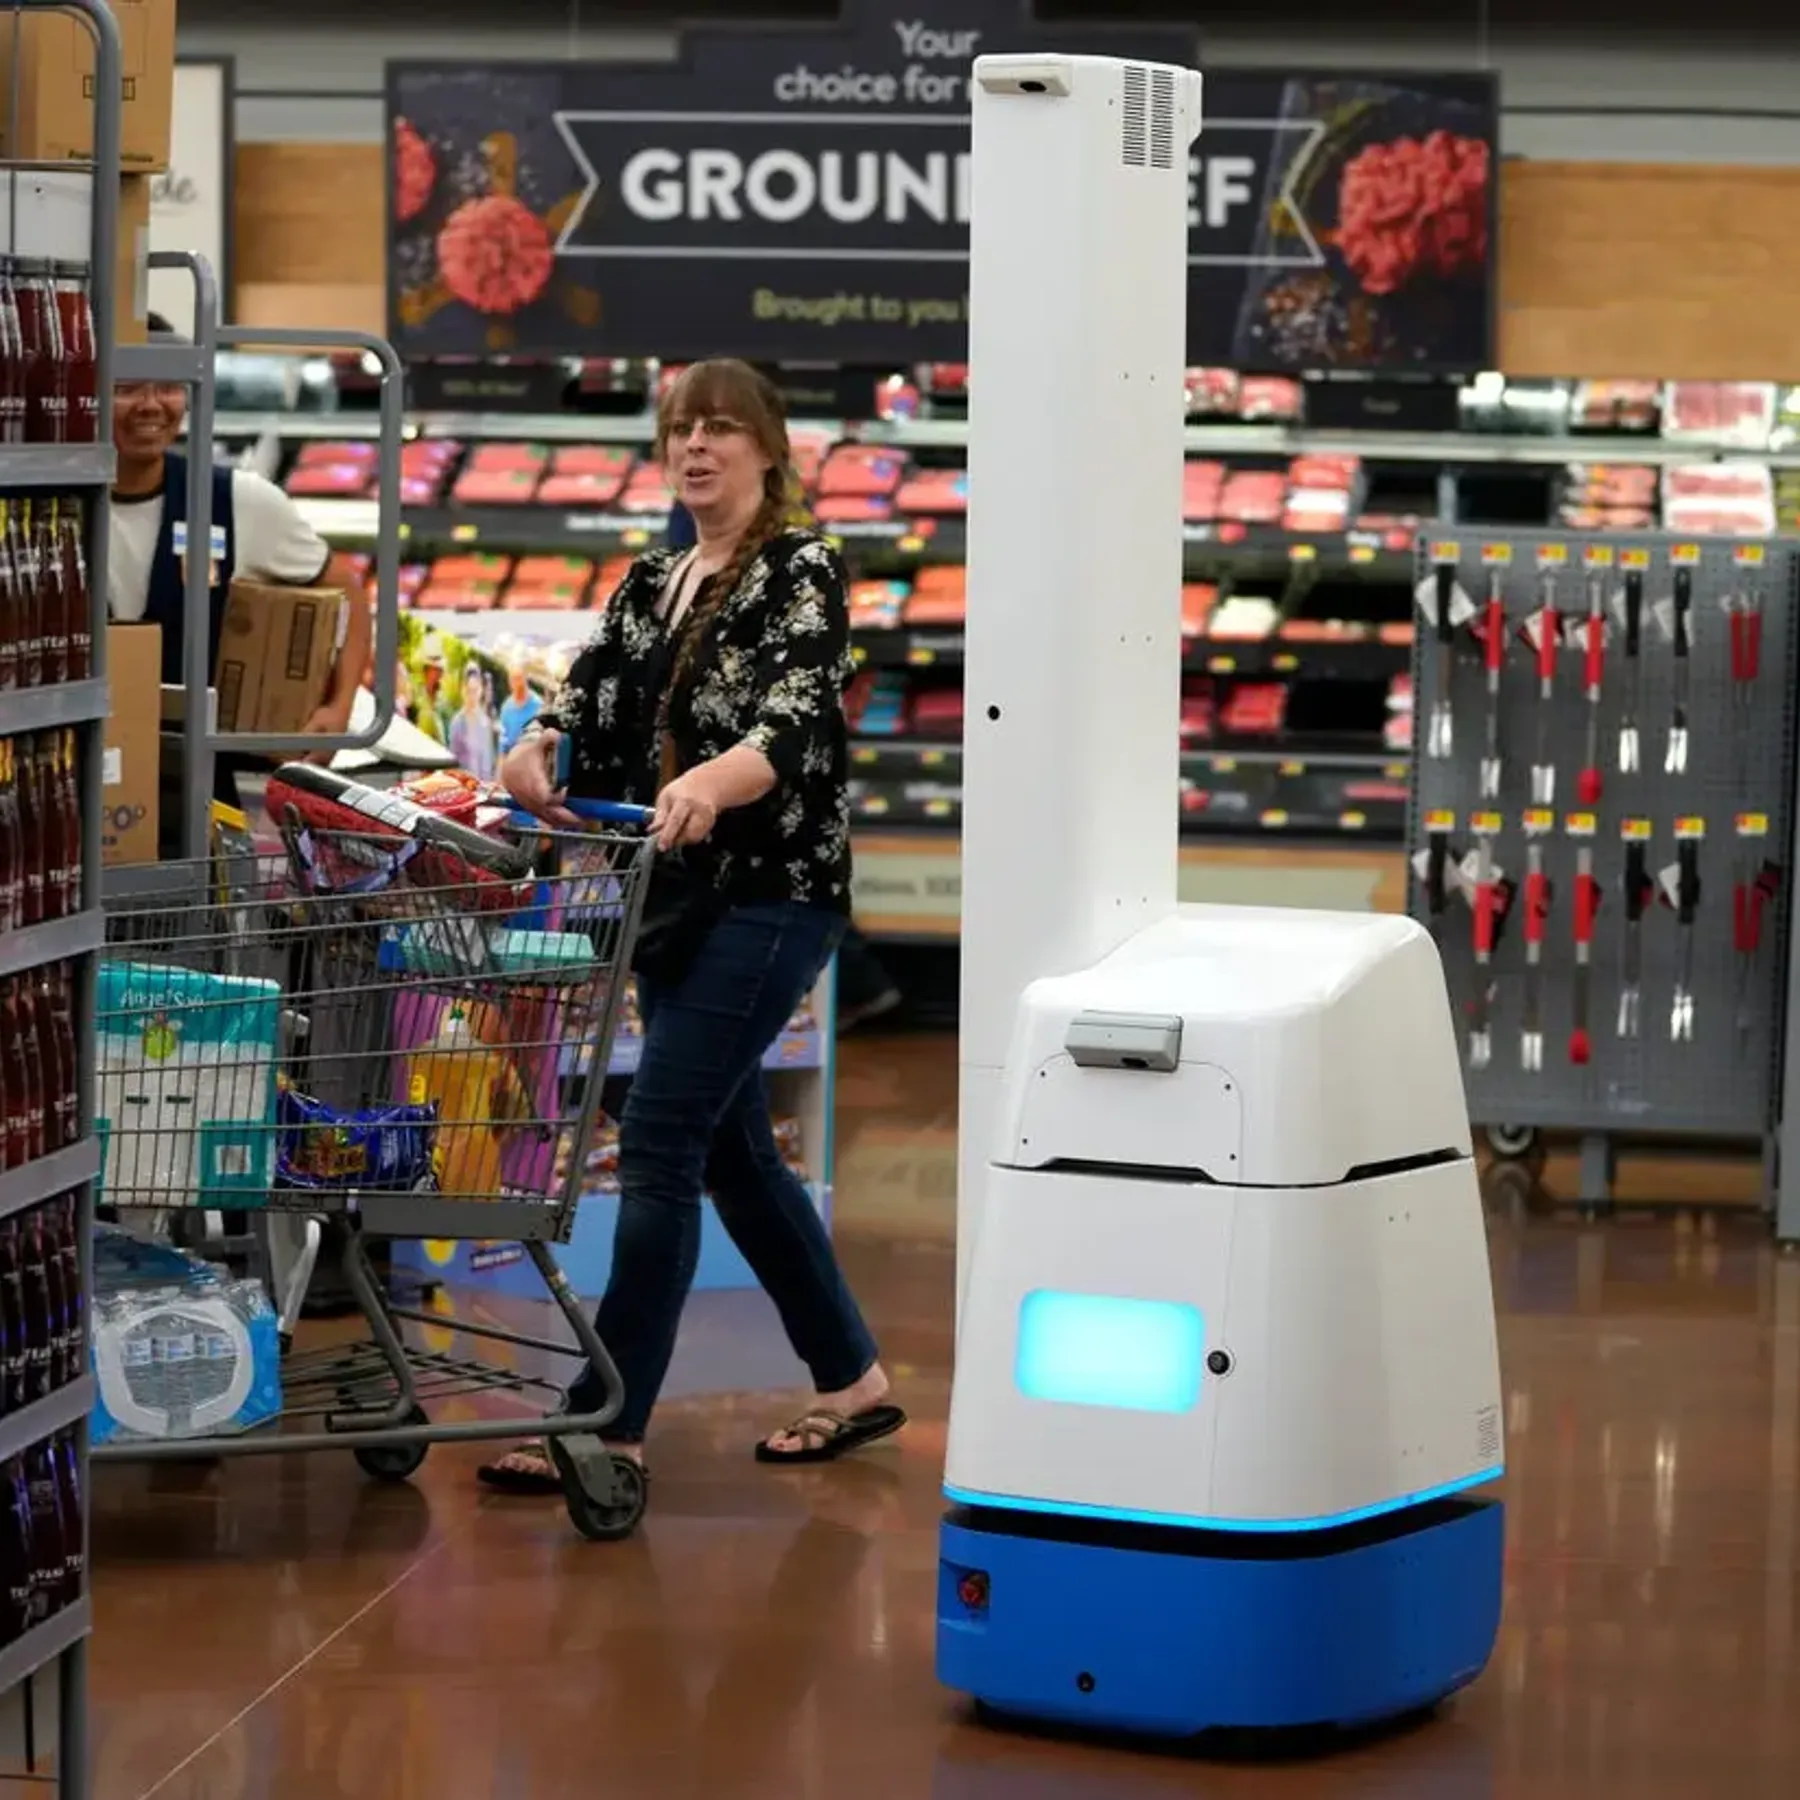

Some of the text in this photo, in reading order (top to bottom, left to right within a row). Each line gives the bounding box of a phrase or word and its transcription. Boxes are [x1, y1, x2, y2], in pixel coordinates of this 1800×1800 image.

[893, 19, 981, 58] Your
[775, 64, 898, 103] choice
[903, 64, 961, 103] for
[620, 148, 970, 223] GROUN
[754, 288, 865, 326] Brought
[870, 293, 901, 321] to
[906, 300, 960, 329] you
